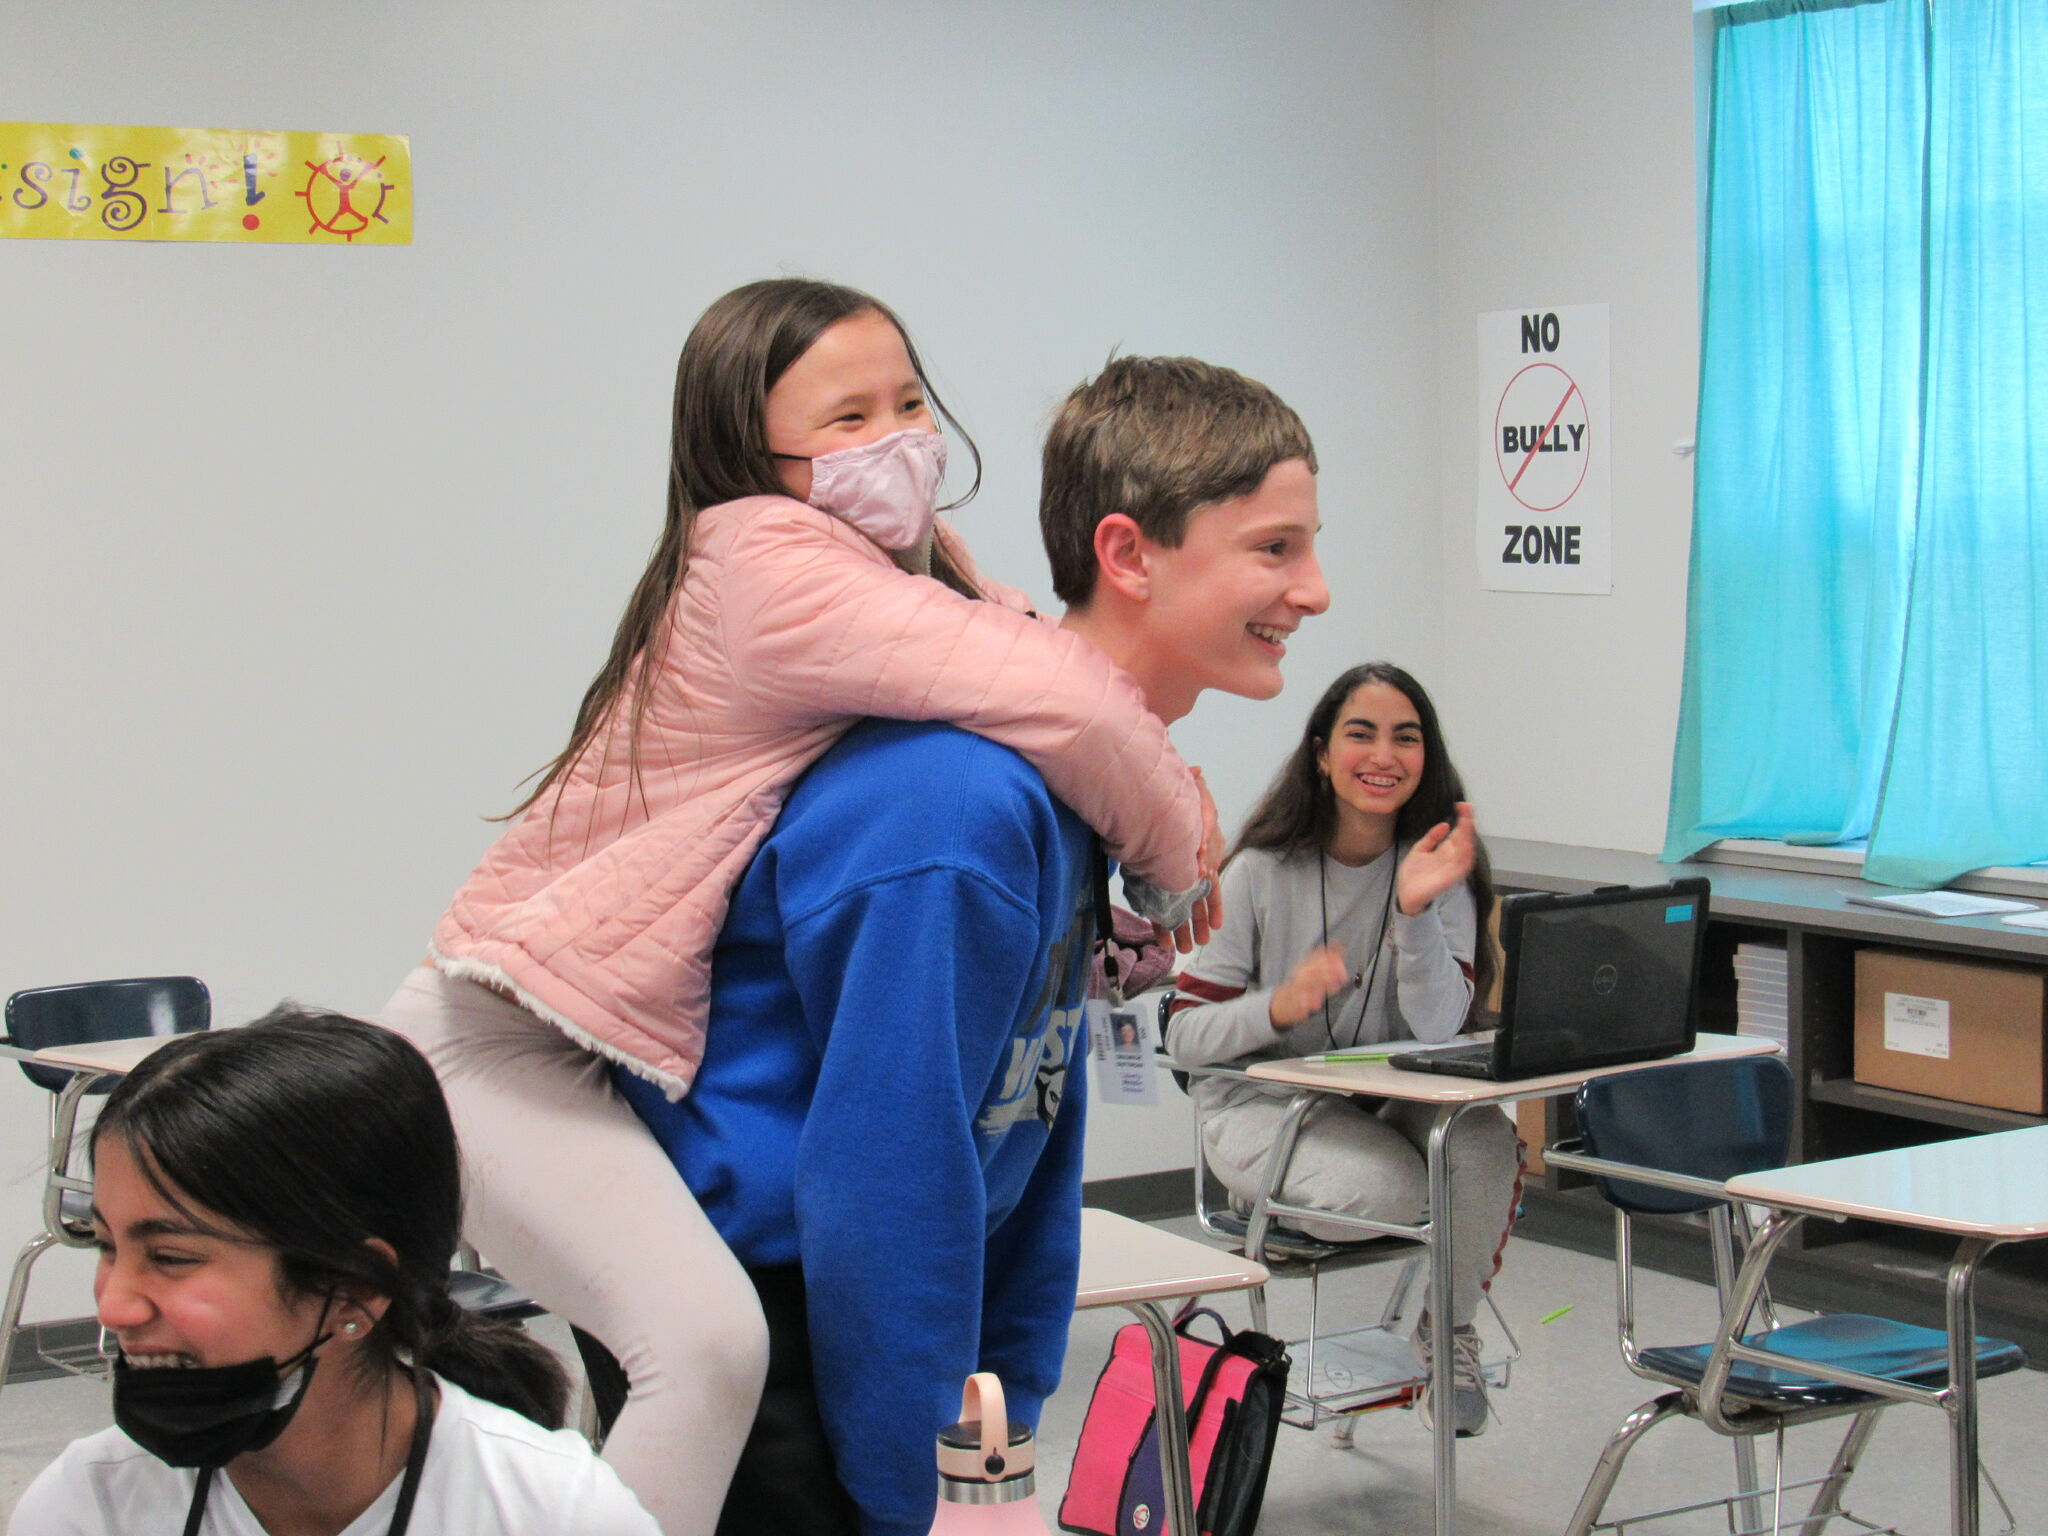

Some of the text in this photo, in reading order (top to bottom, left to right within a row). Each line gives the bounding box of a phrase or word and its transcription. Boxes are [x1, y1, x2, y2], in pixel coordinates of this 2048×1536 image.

[11, 147, 266, 231] sign!
[1521, 312, 1560, 353] NO
[1503, 424, 1585, 453] BULLY
[1502, 525, 1581, 565] ZONE
